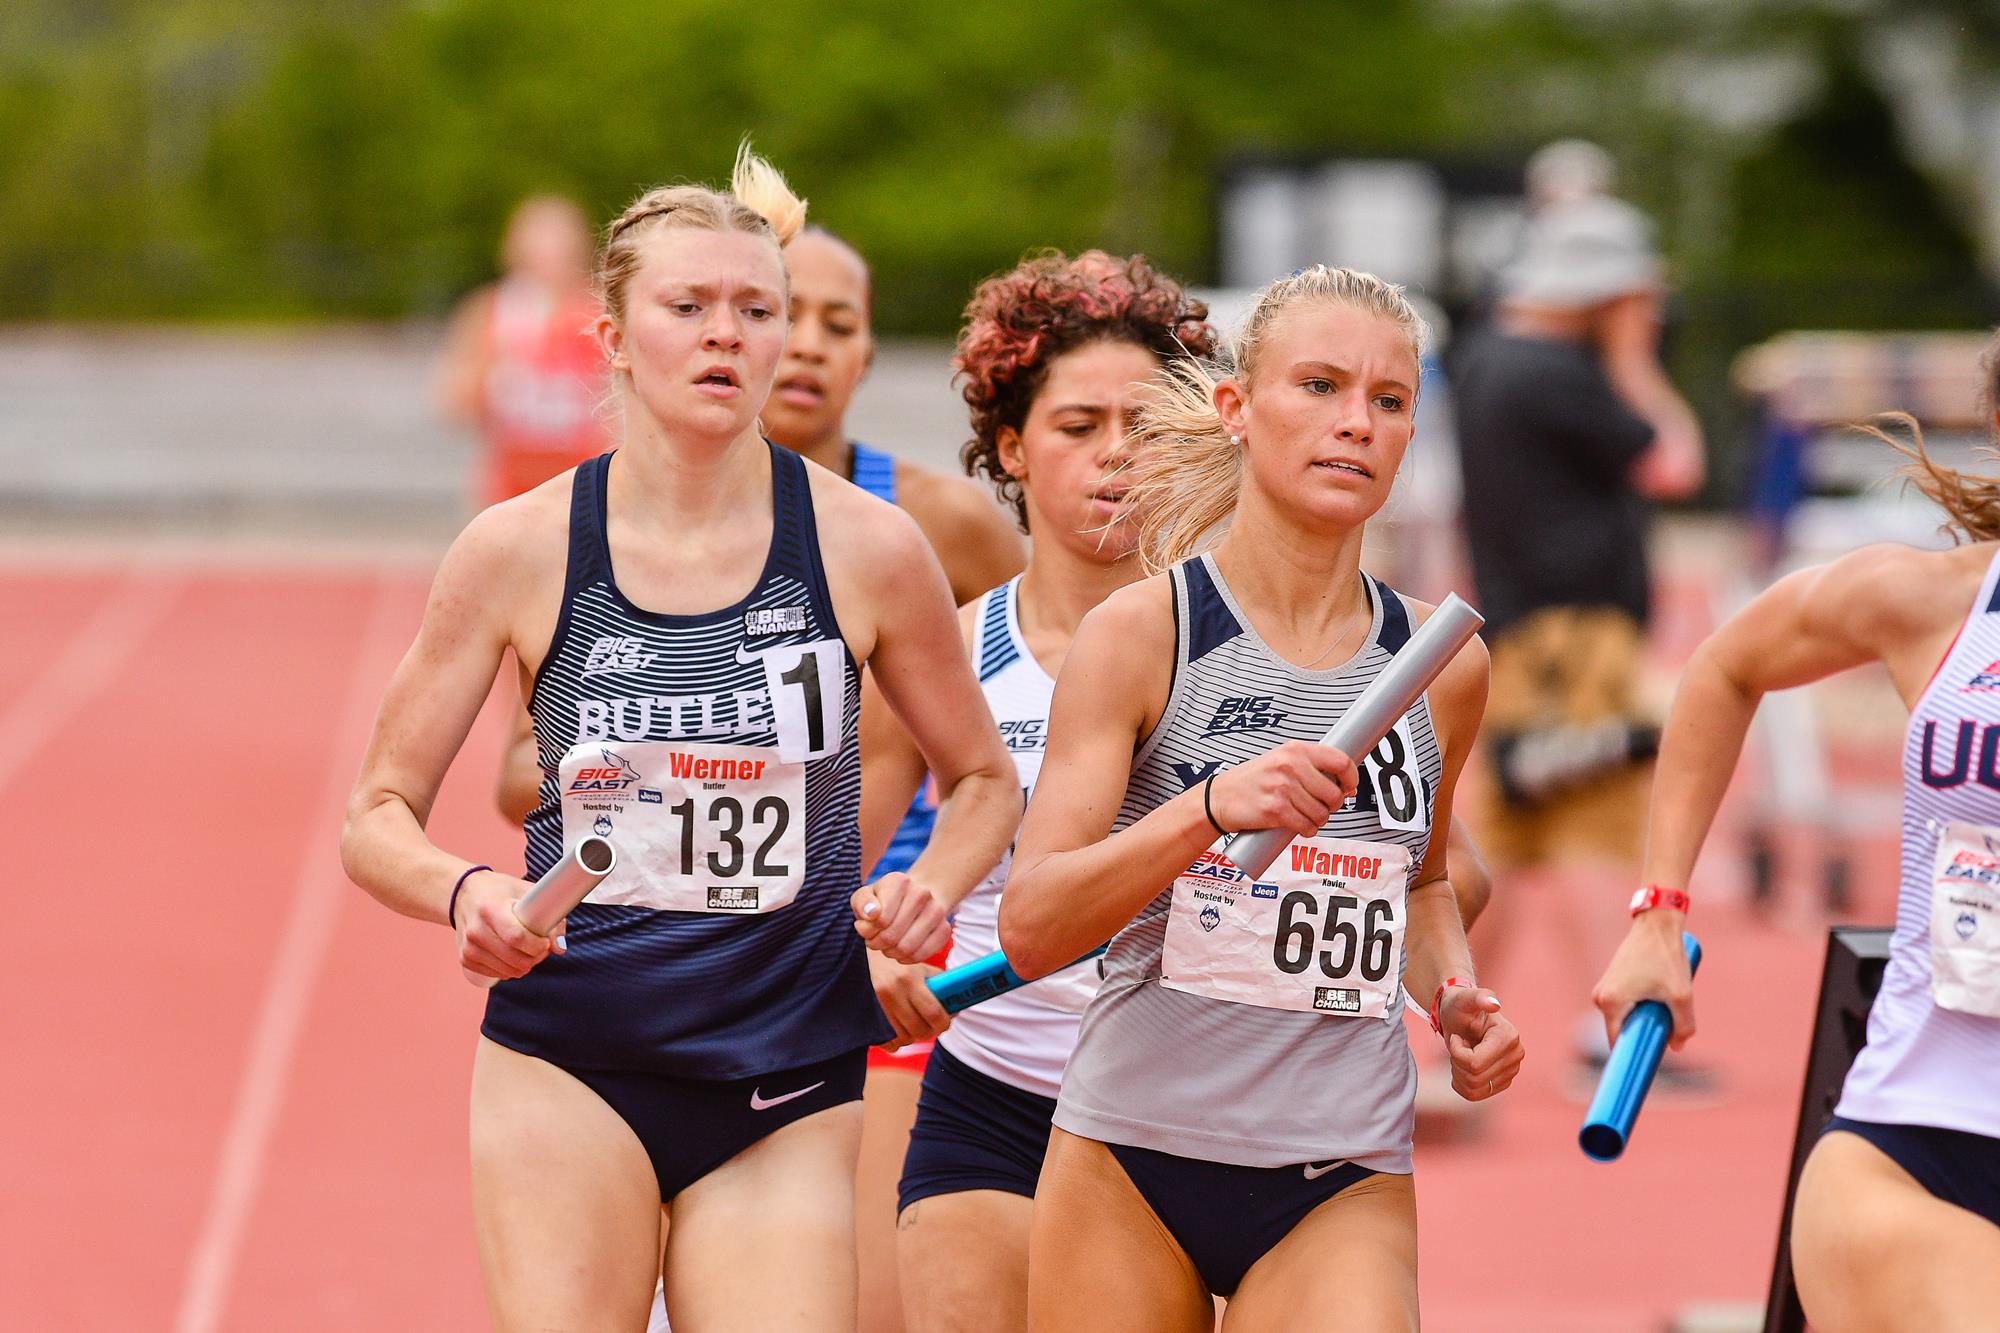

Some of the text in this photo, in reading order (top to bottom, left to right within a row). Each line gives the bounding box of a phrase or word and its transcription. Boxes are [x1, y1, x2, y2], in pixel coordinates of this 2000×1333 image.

[747, 619, 807, 636] CHANGE
[591, 637, 645, 654] BIG
[585, 653, 659, 670] EAST
[782, 651, 824, 752] 1
[1216, 696, 1274, 714] BIG
[576, 691, 773, 744] BUTLE
[1207, 714, 1288, 730] EAST
[576, 768, 622, 780] BIG
[669, 752, 766, 781] Werner
[1371, 728, 1417, 824] 8
[570, 780, 634, 790] EAST
[703, 782, 726, 790] Butler
[640, 791, 661, 803] Jeep
[583, 803, 624, 814] Hosted by
[670, 796, 790, 878] 132
[1291, 845, 1382, 880] Warner
[1322, 879, 1346, 888] Xavier
[1194, 890, 1235, 906] Hosted by
[1254, 887, 1276, 898] Jeep
[709, 899, 757, 908] CHANGE
[1273, 890, 1394, 982] 656
[1315, 1000, 1359, 1010] CHANGE
